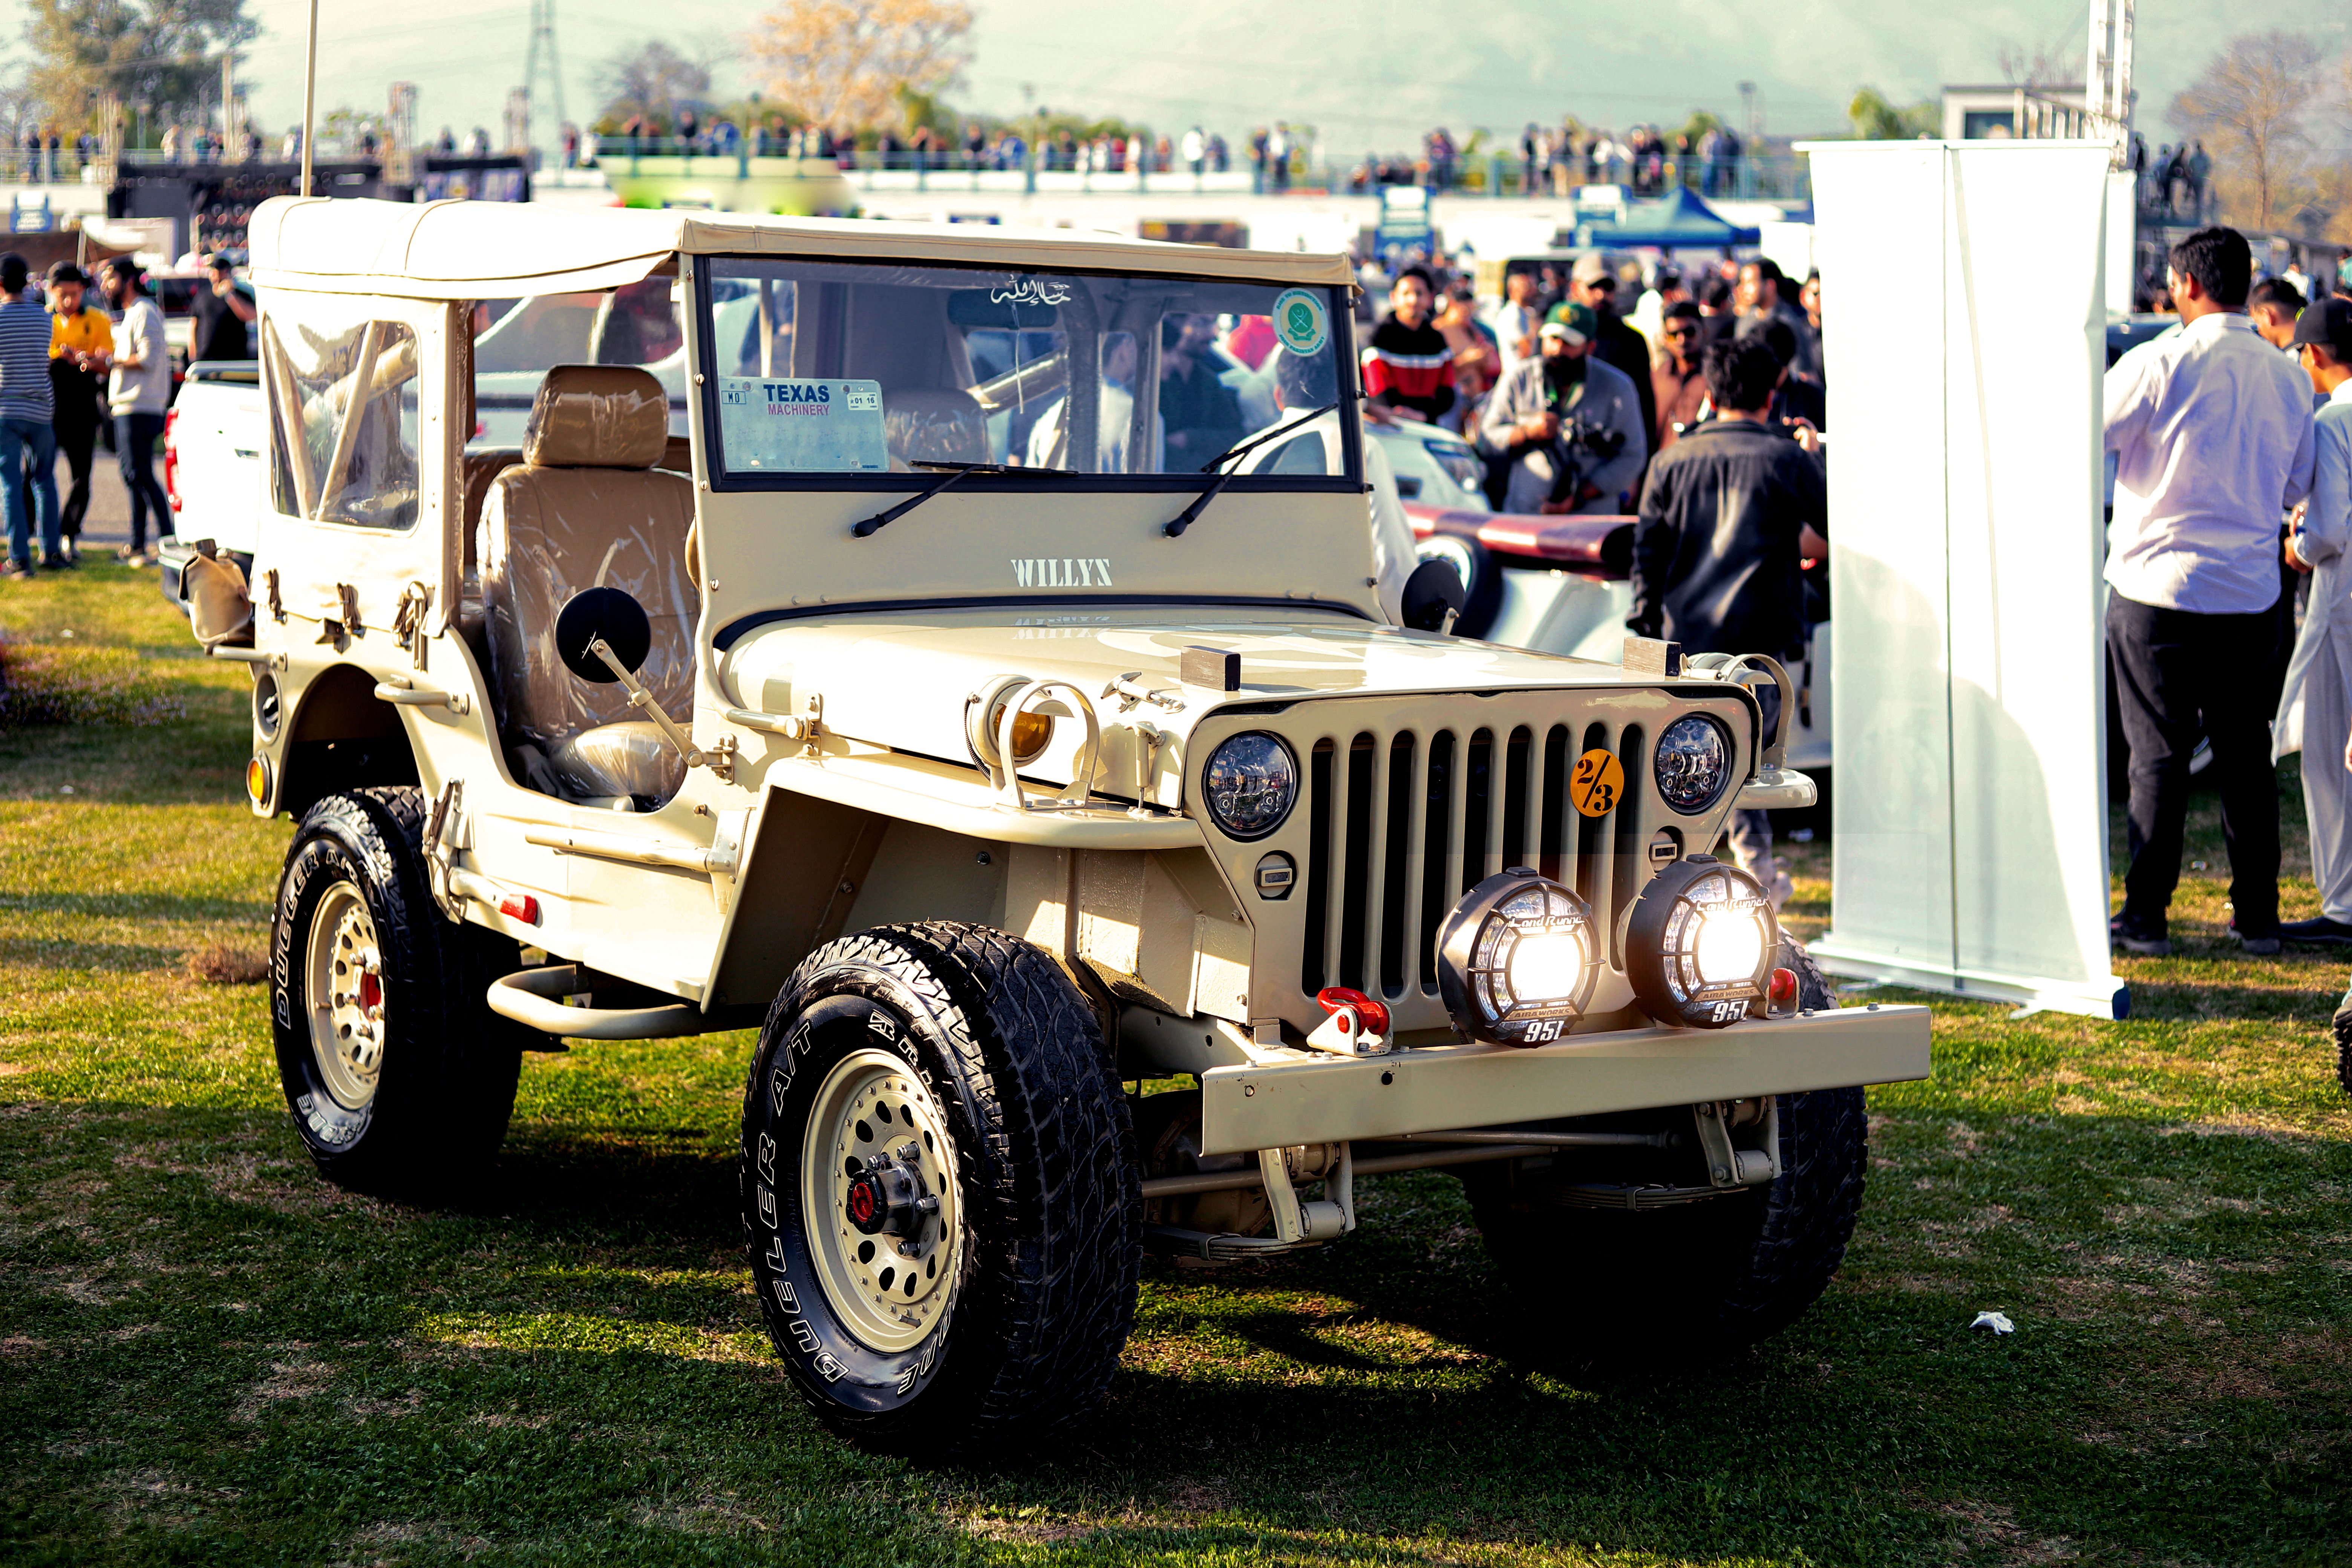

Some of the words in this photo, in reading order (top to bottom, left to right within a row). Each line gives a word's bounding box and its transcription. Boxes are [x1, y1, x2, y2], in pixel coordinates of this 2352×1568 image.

[1314, 336, 1325, 349] ARMY
[763, 384, 830, 403] TEXAS
[768, 404, 830, 416] MACHINERY
[1011, 558, 1112, 587] WILLYS
[1577, 754, 1614, 811] 2/3
[276, 850, 320, 1030] DUELER
[1712, 1000, 1749, 1022] 951
[1524, 1020, 1564, 1042] 951
[771, 1020, 810, 1117] A/T
[758, 1132, 850, 1383] DUELER
